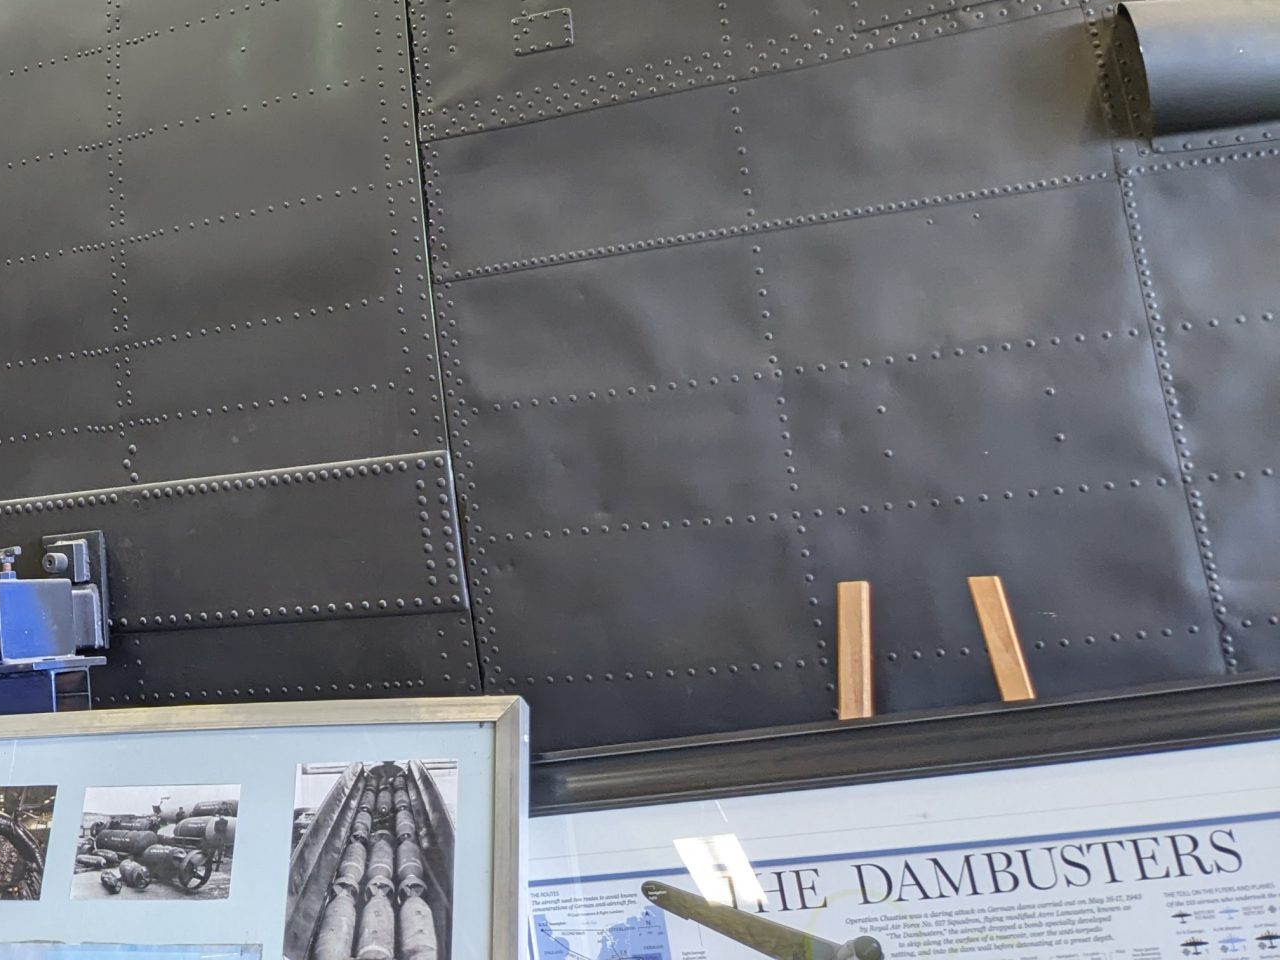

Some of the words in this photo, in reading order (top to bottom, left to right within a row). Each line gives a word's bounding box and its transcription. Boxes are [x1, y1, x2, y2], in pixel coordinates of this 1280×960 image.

[851, 828, 1242, 905] DAMBUSTERS
[846, 916, 878, 924] Operation
[987, 905, 1015, 913] German
[1088, 897, 1104, 905] May
[870, 925, 888, 933] Royal
